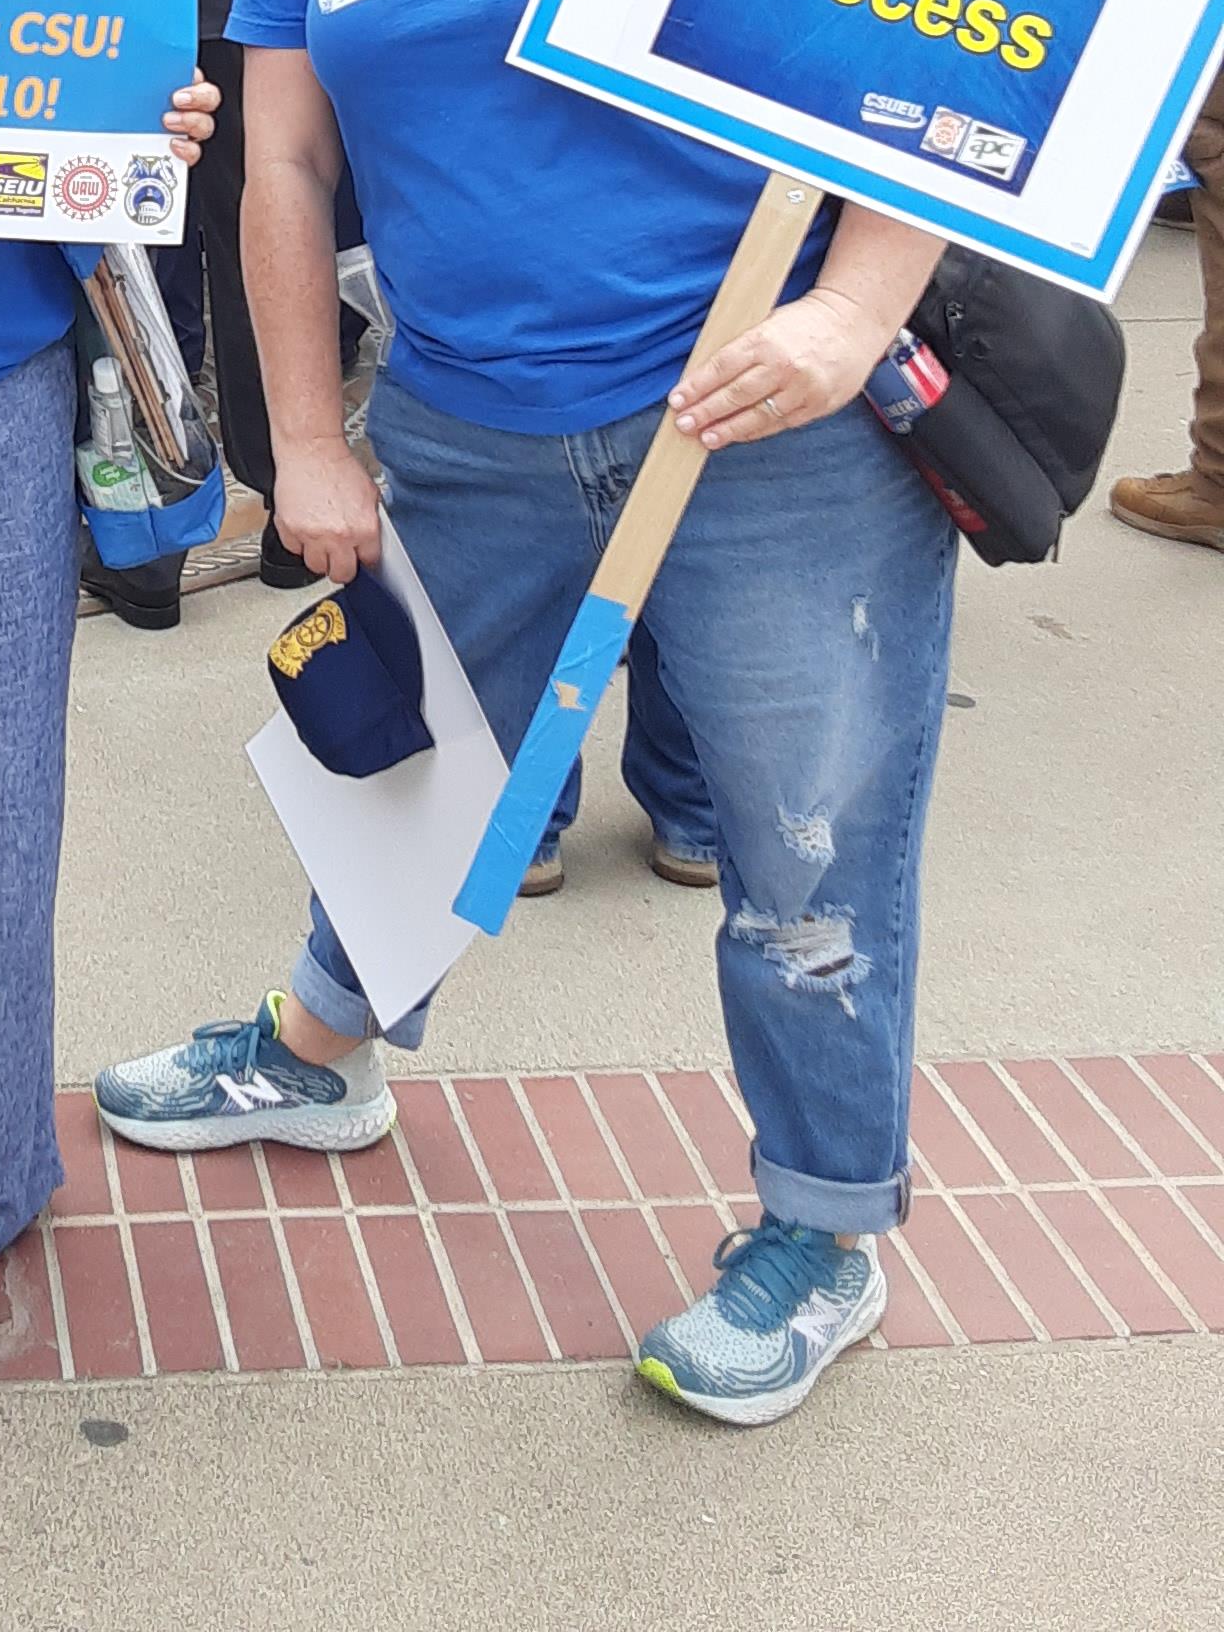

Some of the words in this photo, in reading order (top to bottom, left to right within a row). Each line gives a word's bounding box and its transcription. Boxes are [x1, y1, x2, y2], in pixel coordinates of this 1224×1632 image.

[8, 12, 124, 60] CSU!
[863, 92, 924, 118] CSUEU
[71, 180, 100, 197] UAW
